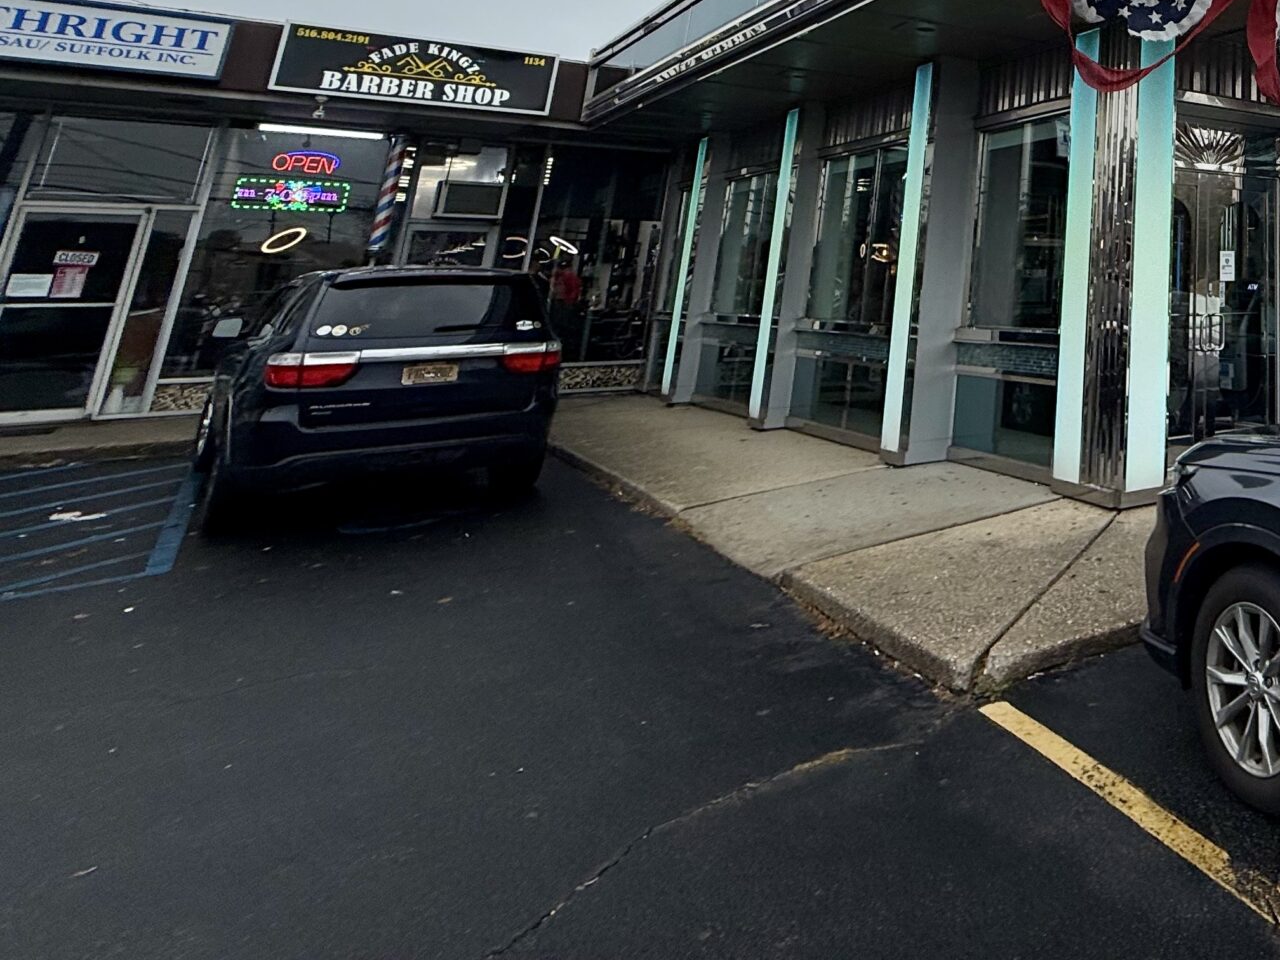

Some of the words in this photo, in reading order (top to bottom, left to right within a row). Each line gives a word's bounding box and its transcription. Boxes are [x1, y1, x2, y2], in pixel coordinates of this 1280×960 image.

[296, 27, 370, 45] 516.804.2191
[54, 41, 152, 61] SUFFOLK
[155, 52, 197, 66] INC.
[368, 42, 419, 64] FADE
[427, 43, 480, 75] KINGZ
[524, 56, 546, 67] 1134
[319, 70, 434, 100] BARBER
[442, 83, 511, 106] SHOP
[272, 154, 336, 175] OPEN
[58, 252, 95, 264] CLOSED
